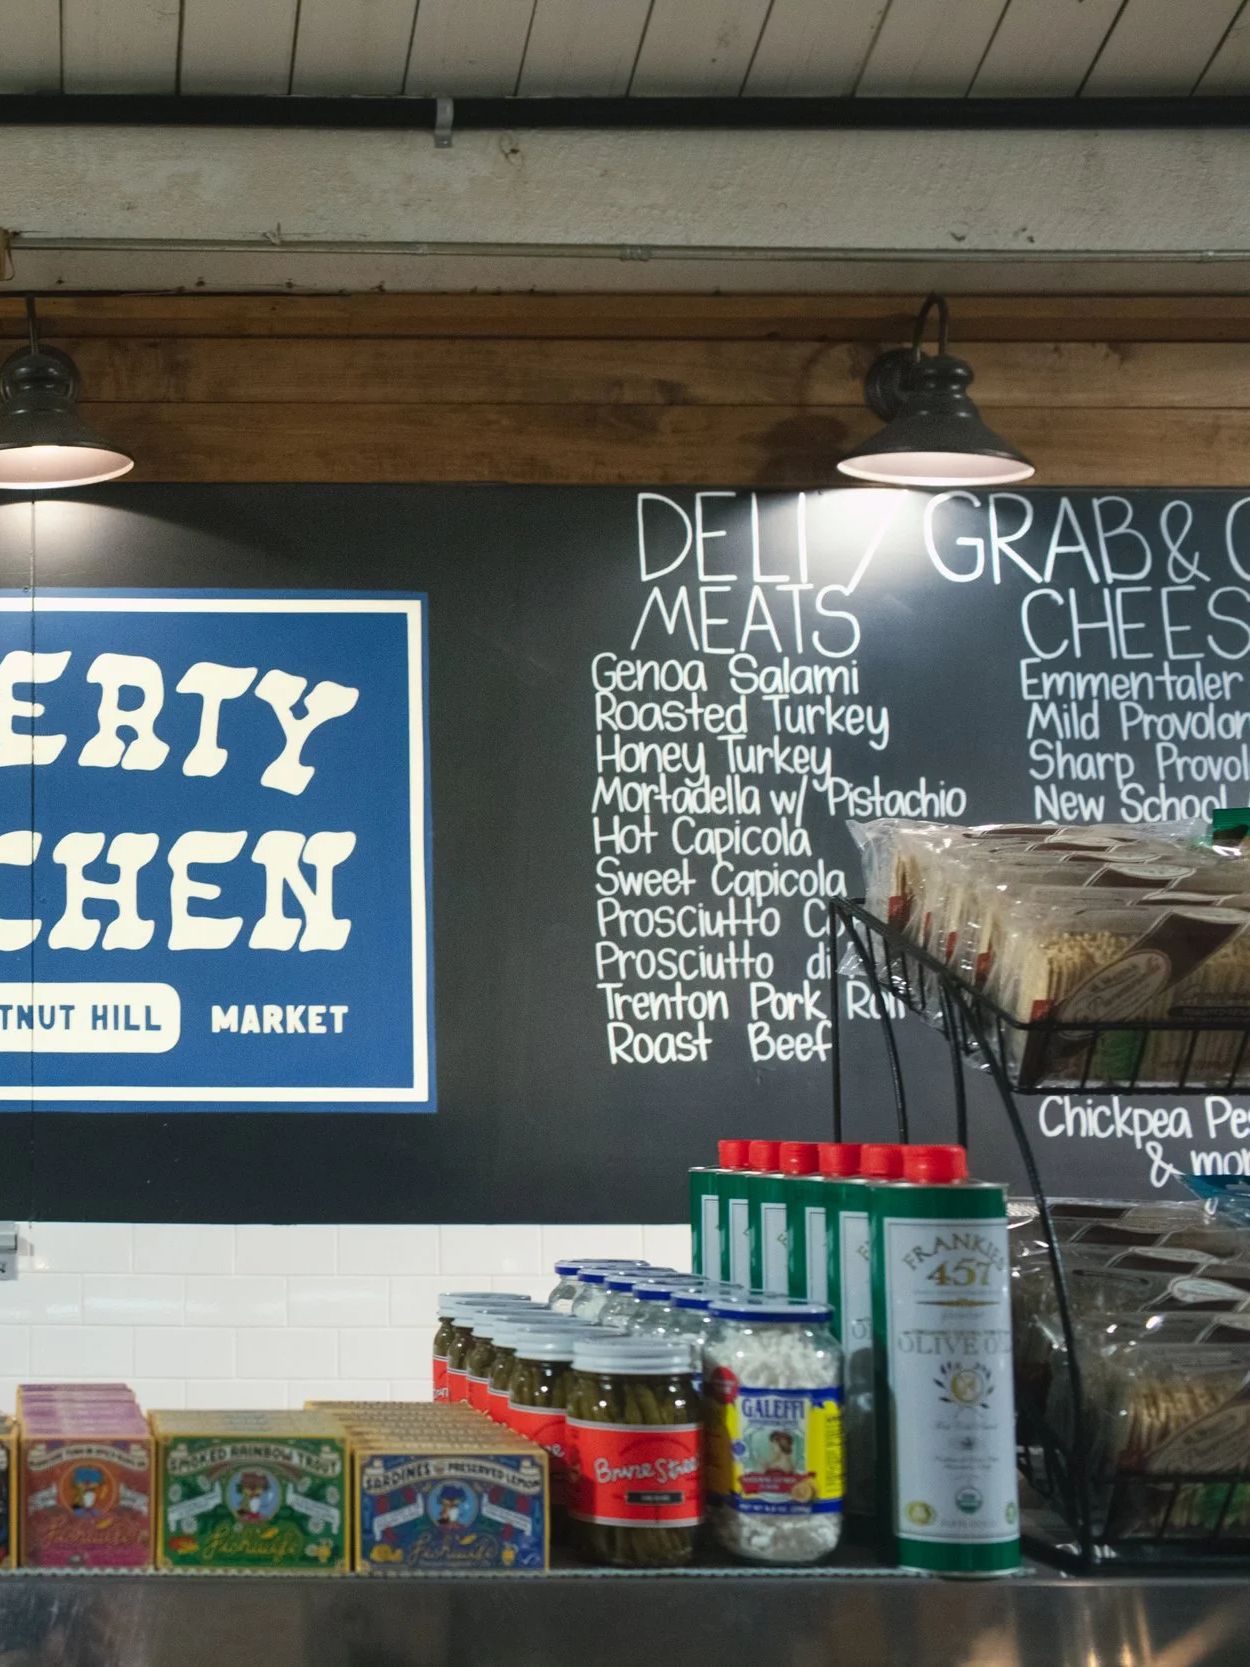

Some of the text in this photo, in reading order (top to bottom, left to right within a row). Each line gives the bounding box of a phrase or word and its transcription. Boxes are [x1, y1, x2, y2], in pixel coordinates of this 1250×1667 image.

[637, 491, 808, 583] DELI
[923, 490, 1152, 584] GRAB
[1160, 500, 1211, 584] &
[631, 583, 861, 658] MEATS
[591, 652, 860, 695] Genoa Salami
[1020, 658, 1243, 701] Emmentaler
[595, 692, 889, 750] Roasted Turkey
[1027, 699, 1100, 740] Mild
[596, 734, 832, 791] Honey Turkey
[1029, 739, 1134, 790] Sharp
[592, 774, 967, 827] Mortadella w/ Pistachio
[1034, 782, 1228, 824] New School
[593, 815, 812, 862] Hot Capicola
[595, 856, 847, 907] Sweet Capicola
[597, 897, 780, 938] Prosciutto
[596, 940, 832, 980] Prosciutto di
[91, 1004, 162, 1031] HILL
[211, 1004, 349, 1034] MARKET
[597, 981, 729, 1020] Trenton
[750, 979, 828, 1020] Pork
[607, 1019, 833, 1064] Roast Beef
[1039, 1095, 1250, 1149] Chickpea Pe
[1145, 1141, 1186, 1188] &
[926, 1257, 991, 1286] 457
[898, 1333, 979, 1355] OLIVE
[741, 1398, 806, 1419] GALEFFI
[230, 1445, 292, 1461] RAINBOW
[366, 1462, 430, 1490] SARDINES
[449, 1462, 503, 1480] PRESERVED
